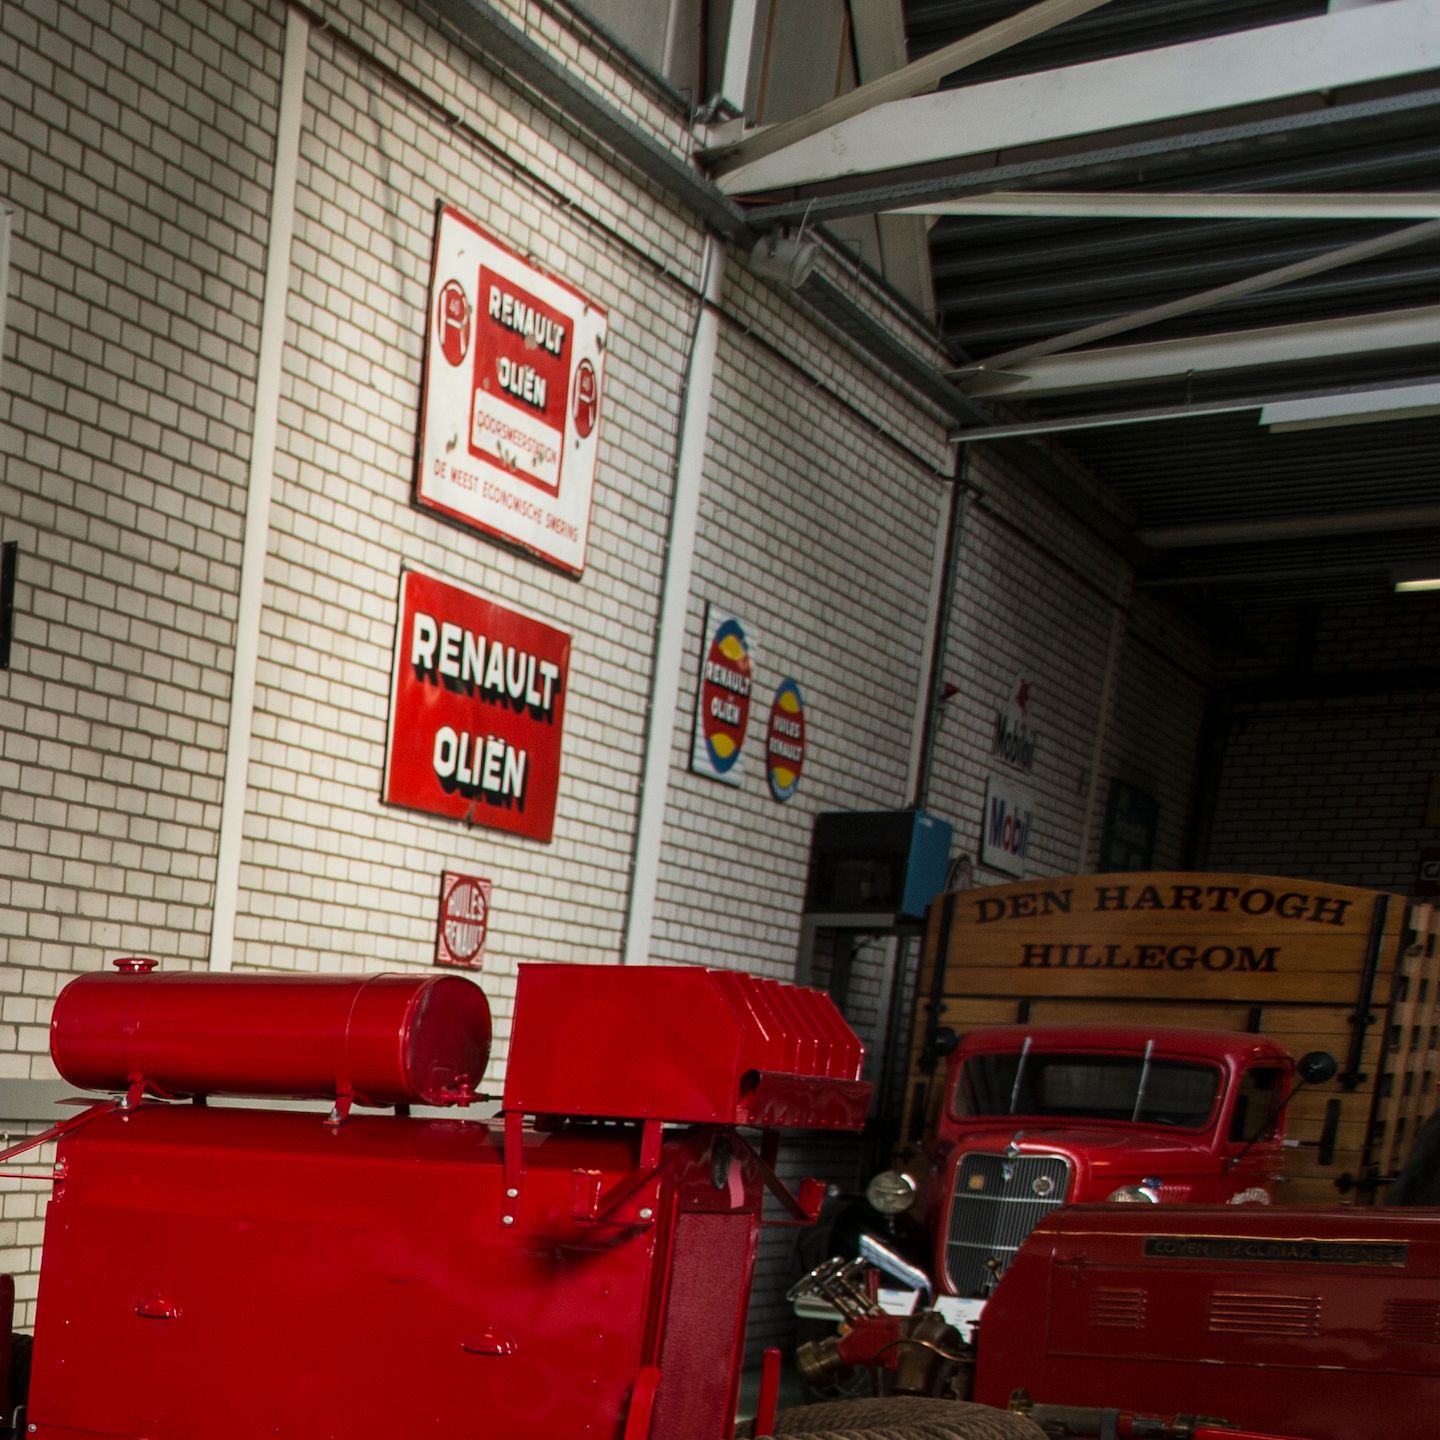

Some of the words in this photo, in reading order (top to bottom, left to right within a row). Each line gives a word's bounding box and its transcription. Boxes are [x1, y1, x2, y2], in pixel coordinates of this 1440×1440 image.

[488, 284, 566, 358] RENAULT
[497, 356, 548, 411] OLIËN
[434, 459, 447, 479] DE
[411, 610, 561, 719] RENAULT
[706, 661, 750, 698] RENAULT
[433, 724, 528, 806] OLIËN
[973, 888, 1075, 925] DEN
[1093, 883, 1353, 929] HARTOGH
[1019, 942, 1282, 974] HILLEGOM
